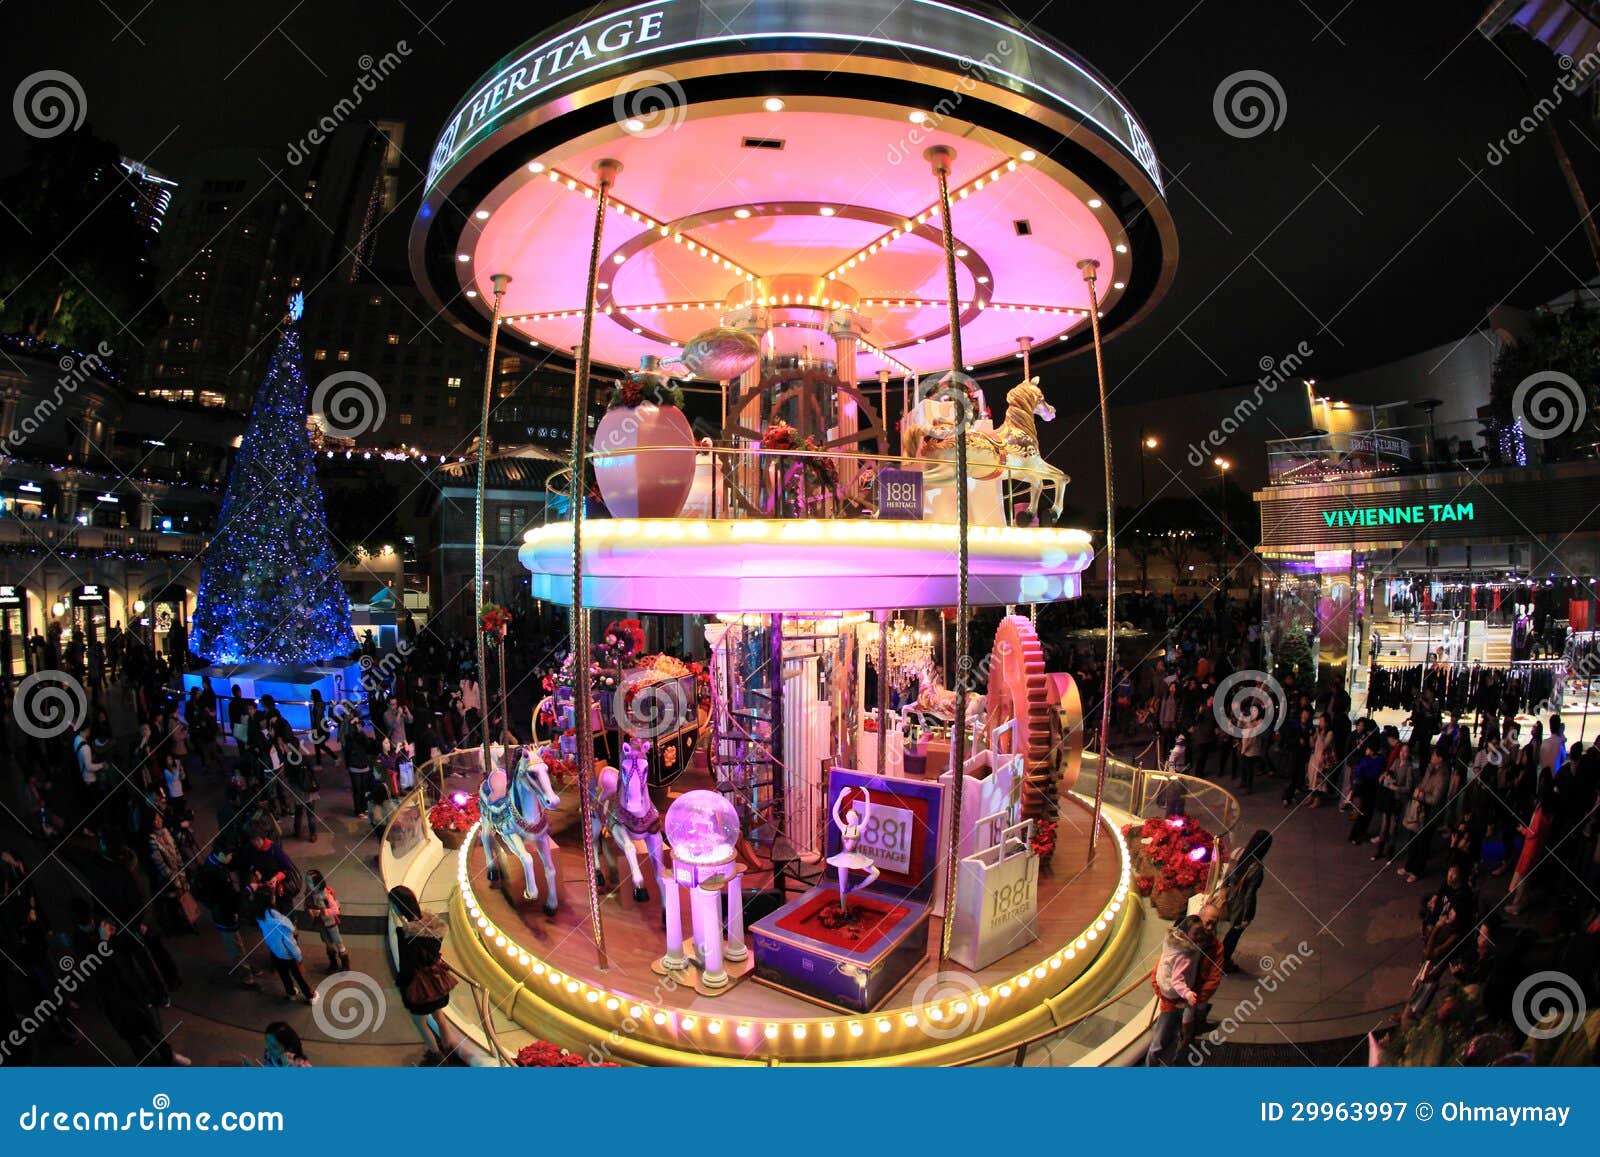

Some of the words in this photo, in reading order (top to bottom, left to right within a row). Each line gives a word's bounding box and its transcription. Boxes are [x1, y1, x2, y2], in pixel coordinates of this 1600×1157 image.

[466, 11, 664, 131] HERITAGE
[886, 482, 917, 502] 1881
[1322, 506, 1425, 528] VIVIENNE
[1428, 502, 1475, 522] TAM
[992, 877, 1031, 918] 1881
